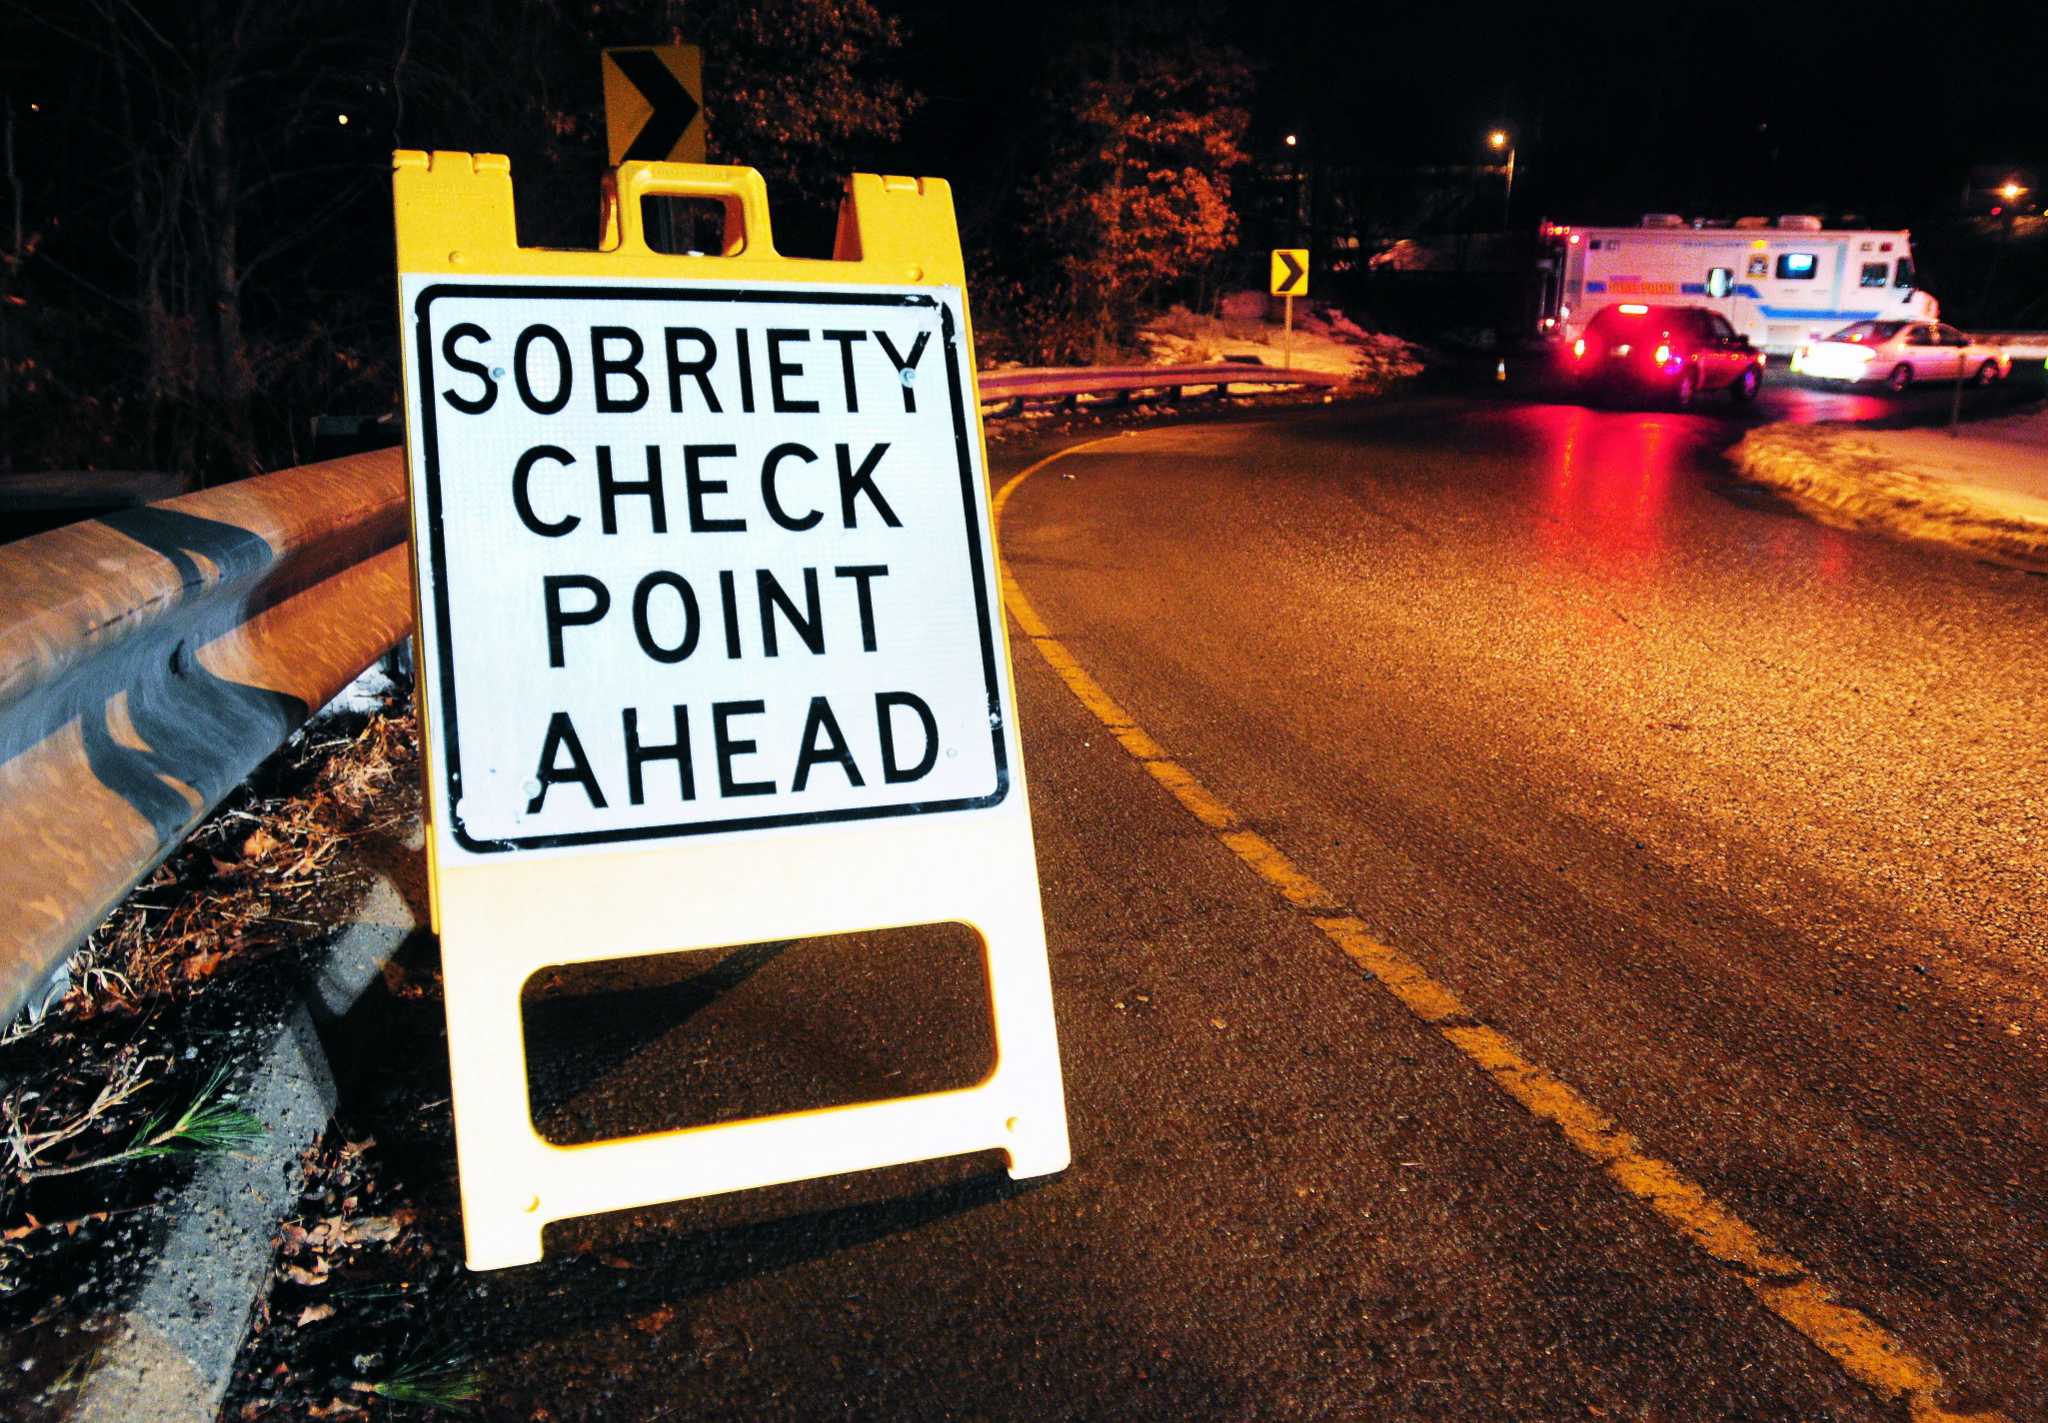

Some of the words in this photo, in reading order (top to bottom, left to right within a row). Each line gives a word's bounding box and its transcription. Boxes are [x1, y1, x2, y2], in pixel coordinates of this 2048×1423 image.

[441, 322, 932, 415] SOBRIETY
[511, 442, 904, 538] CHECK
[543, 564, 889, 668] POINT
[525, 691, 940, 815] AHEAD
